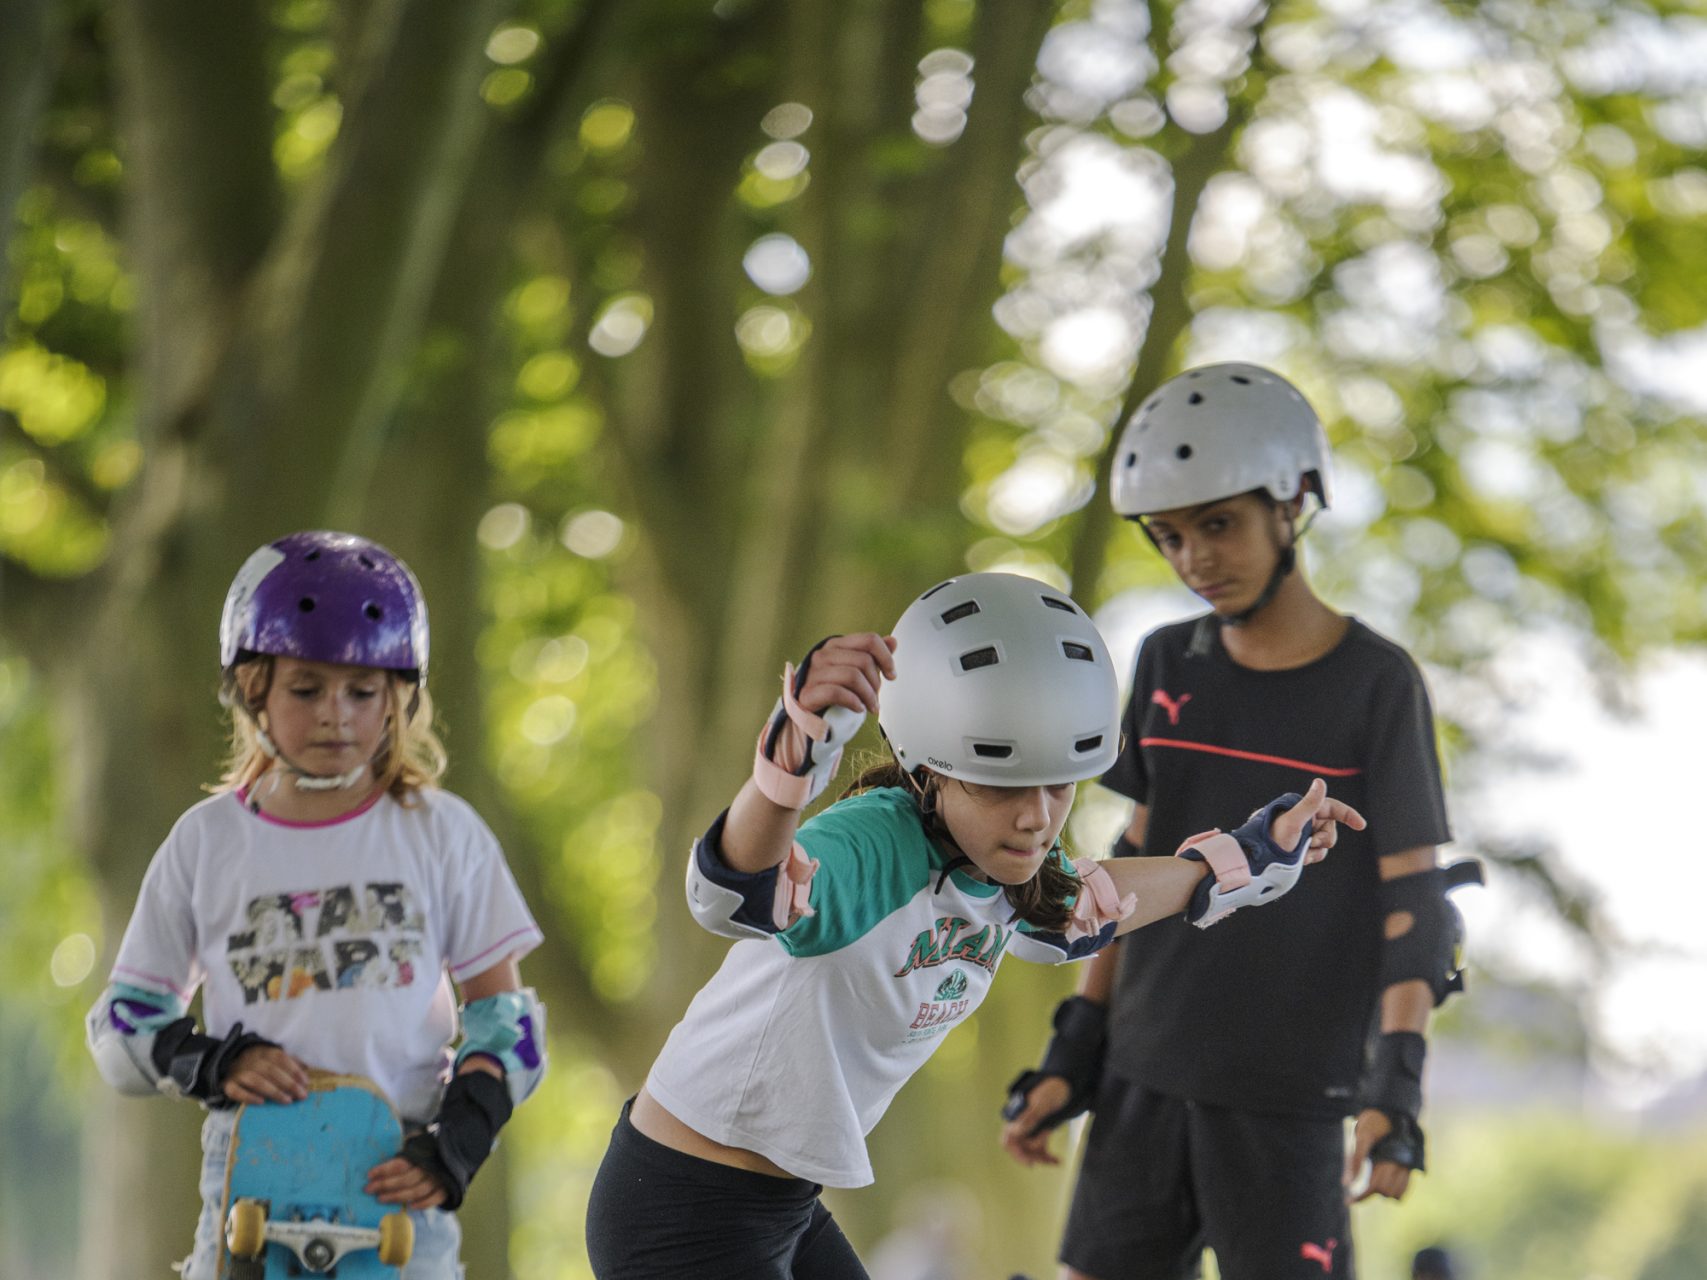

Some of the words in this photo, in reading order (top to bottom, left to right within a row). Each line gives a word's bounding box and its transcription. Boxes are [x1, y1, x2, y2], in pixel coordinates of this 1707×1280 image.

[927, 756, 953, 771] oxelo
[227, 882, 426, 952] STAR
[227, 938, 424, 1005] WARS
[910, 999, 969, 1030] BEACH
